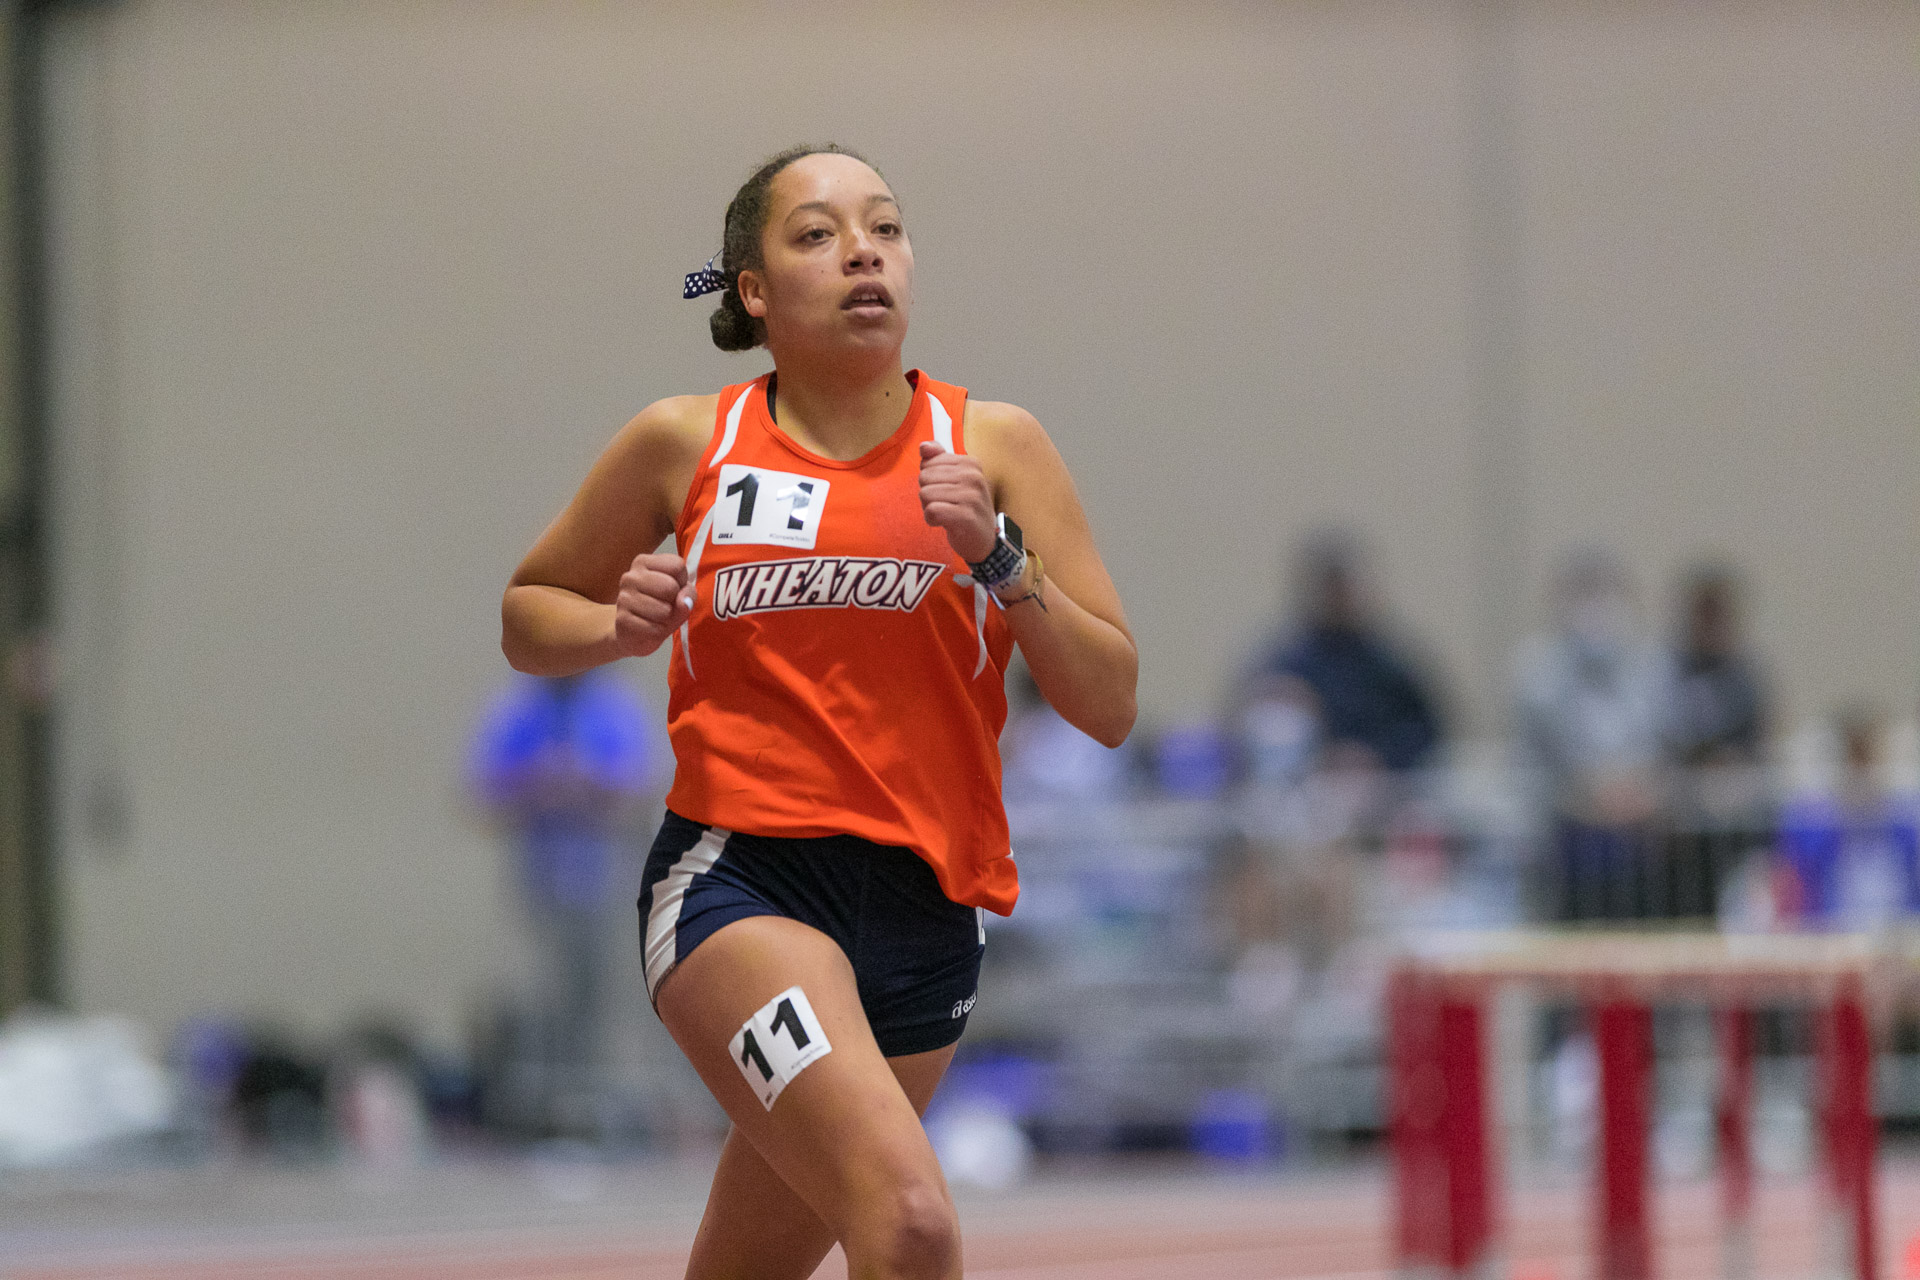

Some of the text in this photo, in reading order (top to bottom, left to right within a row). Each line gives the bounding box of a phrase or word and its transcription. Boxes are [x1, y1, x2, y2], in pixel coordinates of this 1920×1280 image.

[726, 473, 814, 531] 11
[713, 556, 946, 621] WHEATON
[741, 997, 811, 1083] 11
